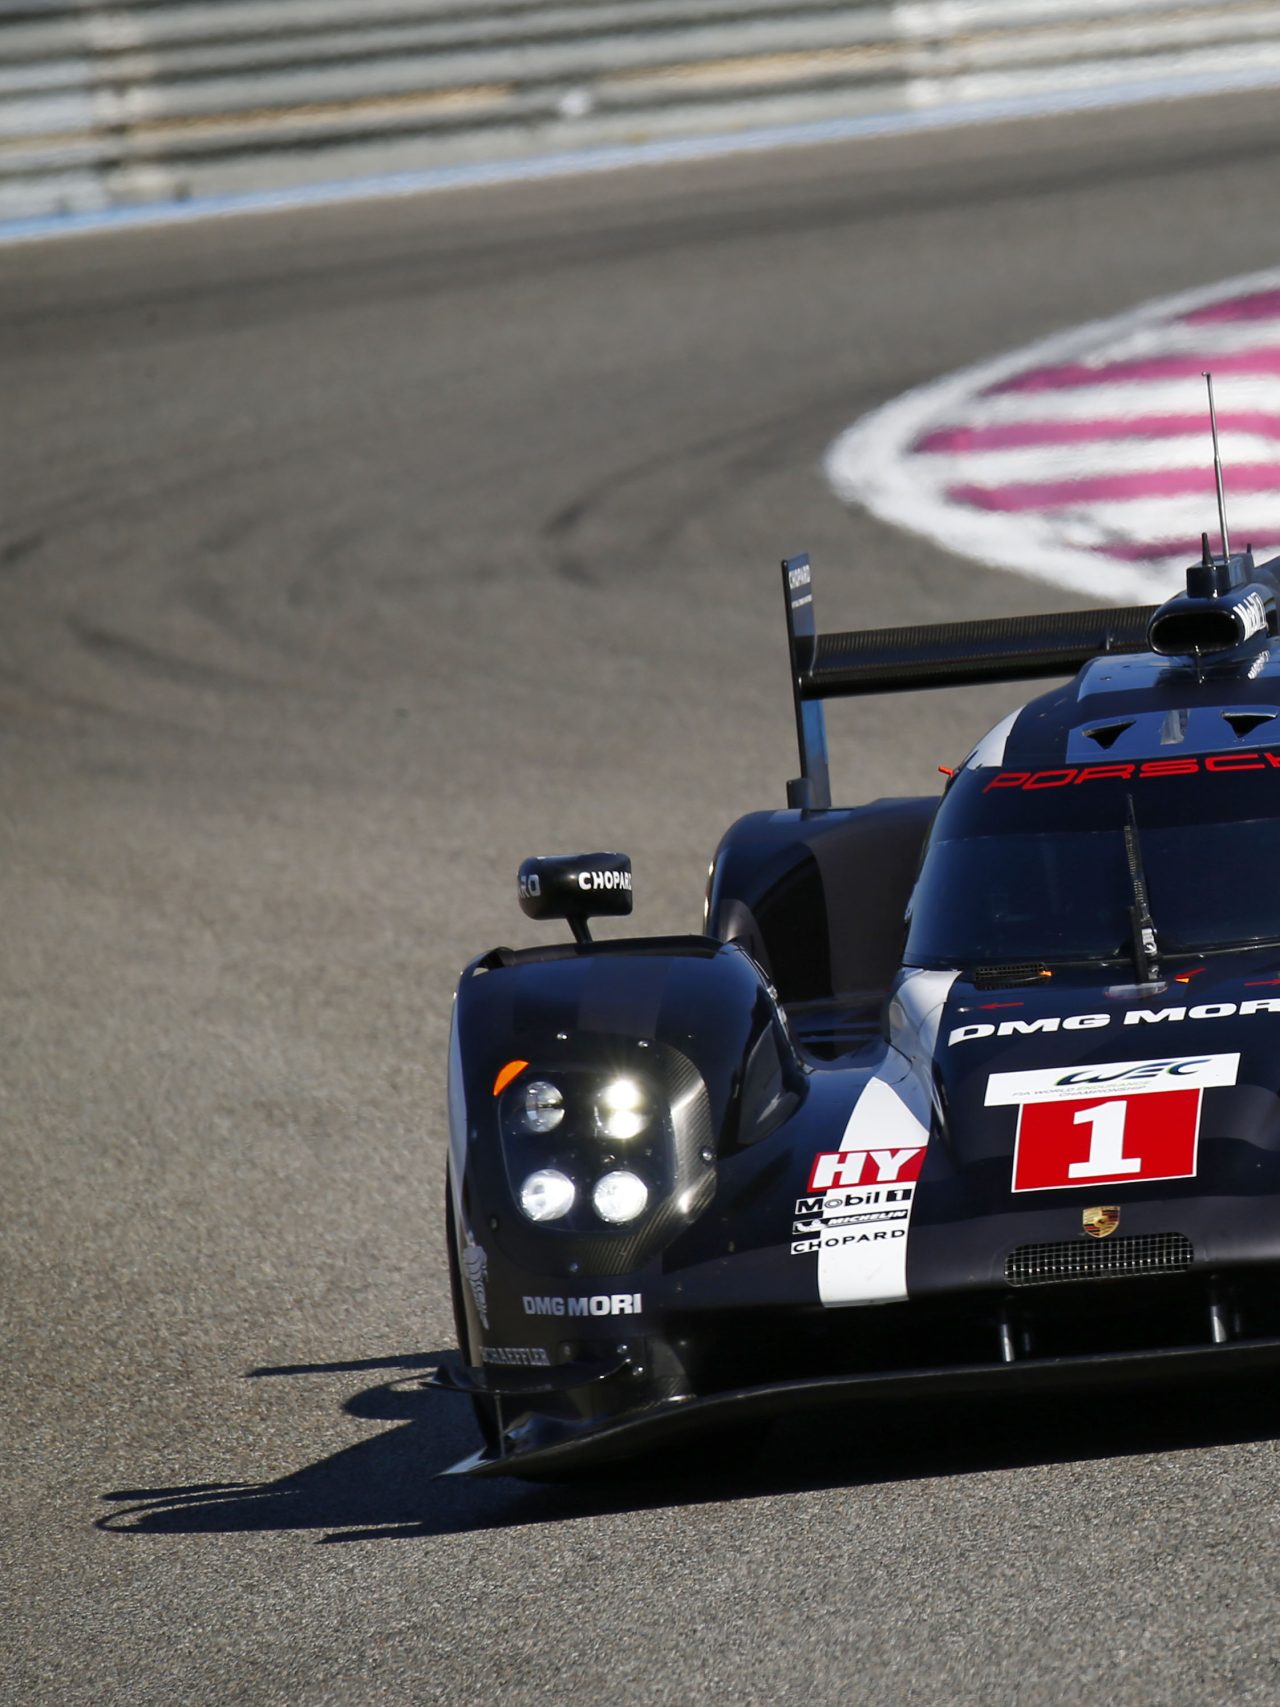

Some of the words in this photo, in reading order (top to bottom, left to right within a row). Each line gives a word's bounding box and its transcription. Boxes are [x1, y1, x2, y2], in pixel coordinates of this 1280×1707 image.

[948, 1013, 1111, 1047] DMG
[1055, 1059, 1212, 1086] WEC
[1068, 1100, 1142, 1179] 1
[812, 1149, 922, 1188] HY
[797, 1190, 880, 1213] Mobil
[827, 1210, 907, 1226] MICHELIN
[793, 1229, 906, 1253] CHOPARD
[522, 1296, 565, 1315] DMG
[568, 1293, 642, 1316] MORI
